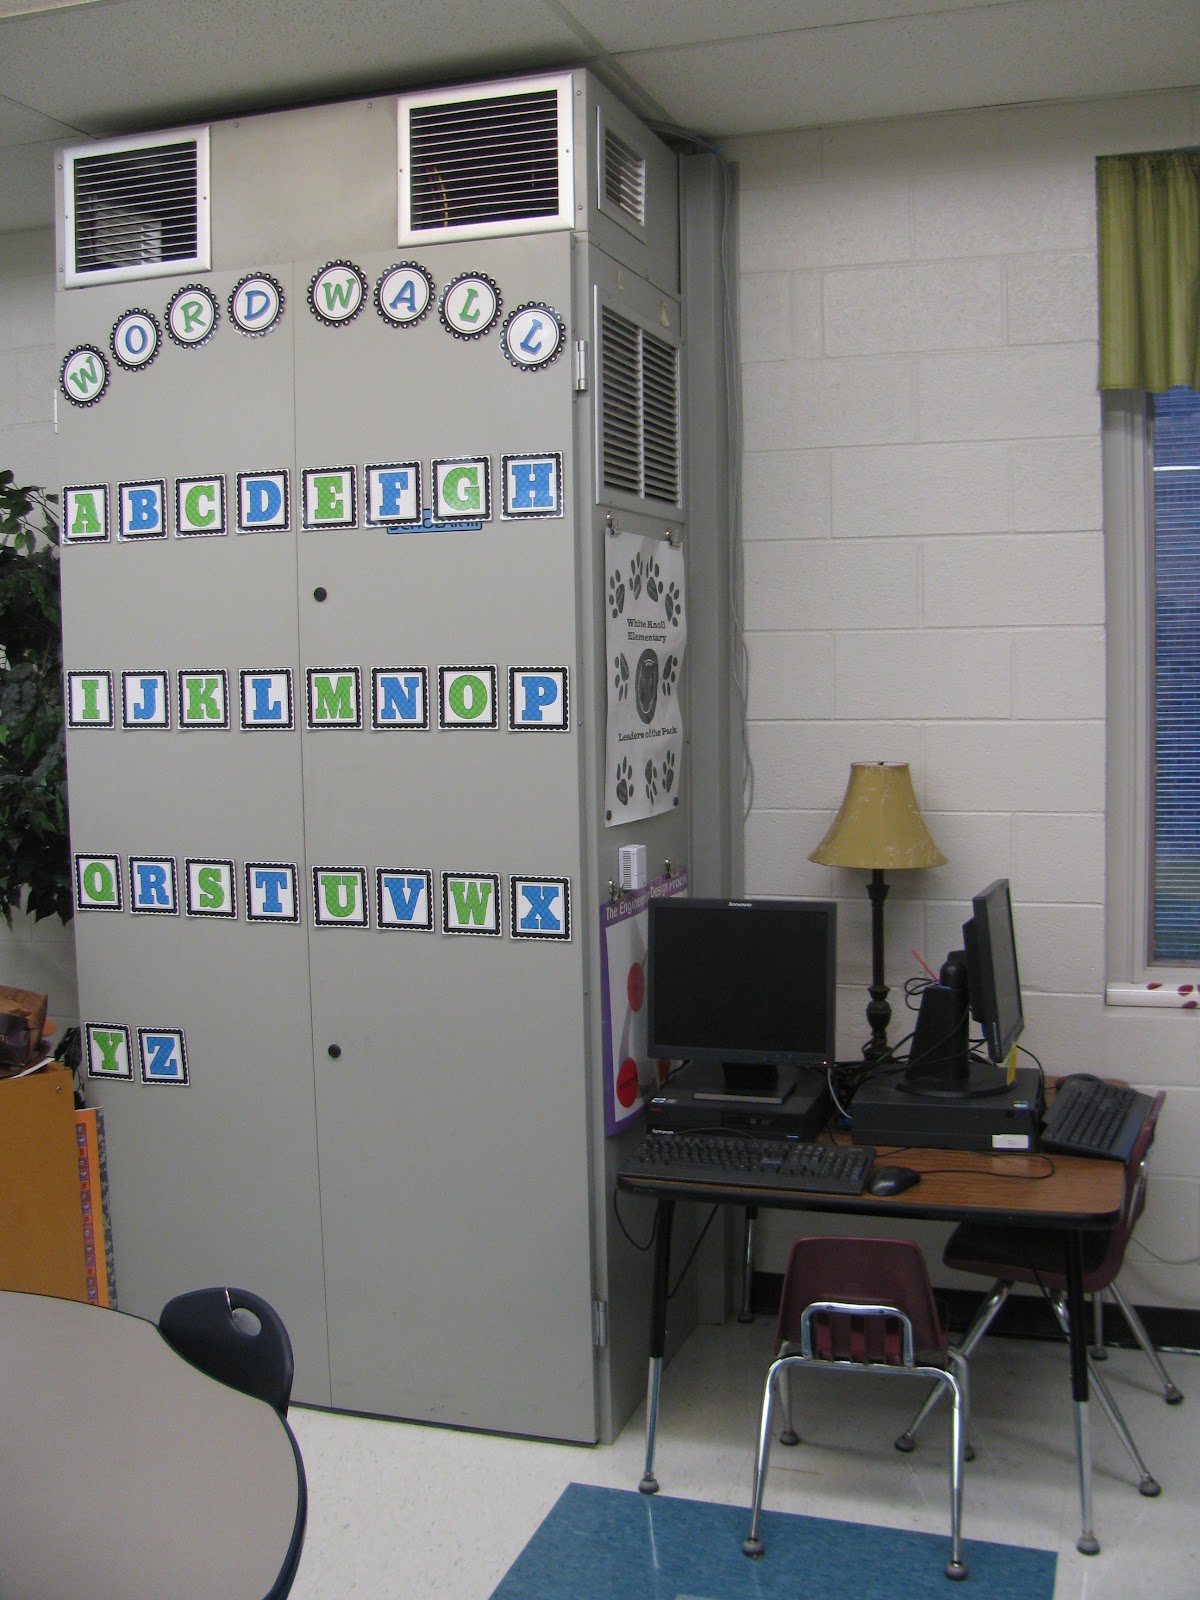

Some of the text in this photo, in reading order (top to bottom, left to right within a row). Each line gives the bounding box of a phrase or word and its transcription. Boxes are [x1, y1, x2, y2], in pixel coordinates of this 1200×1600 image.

[72, 463, 553, 533] A B C D E F G H
[627, 618, 666, 629] White Knoll
[627, 632, 667, 643] Elementary
[81, 674, 558, 721] I J K L M N O P
[618, 732, 645, 742] Leaders
[661, 726, 678, 736] Pack
[83, 862, 561, 931] Q R S T U V W X
[606, 907, 618, 920] The
[92, 1031, 178, 1076] Y Z
